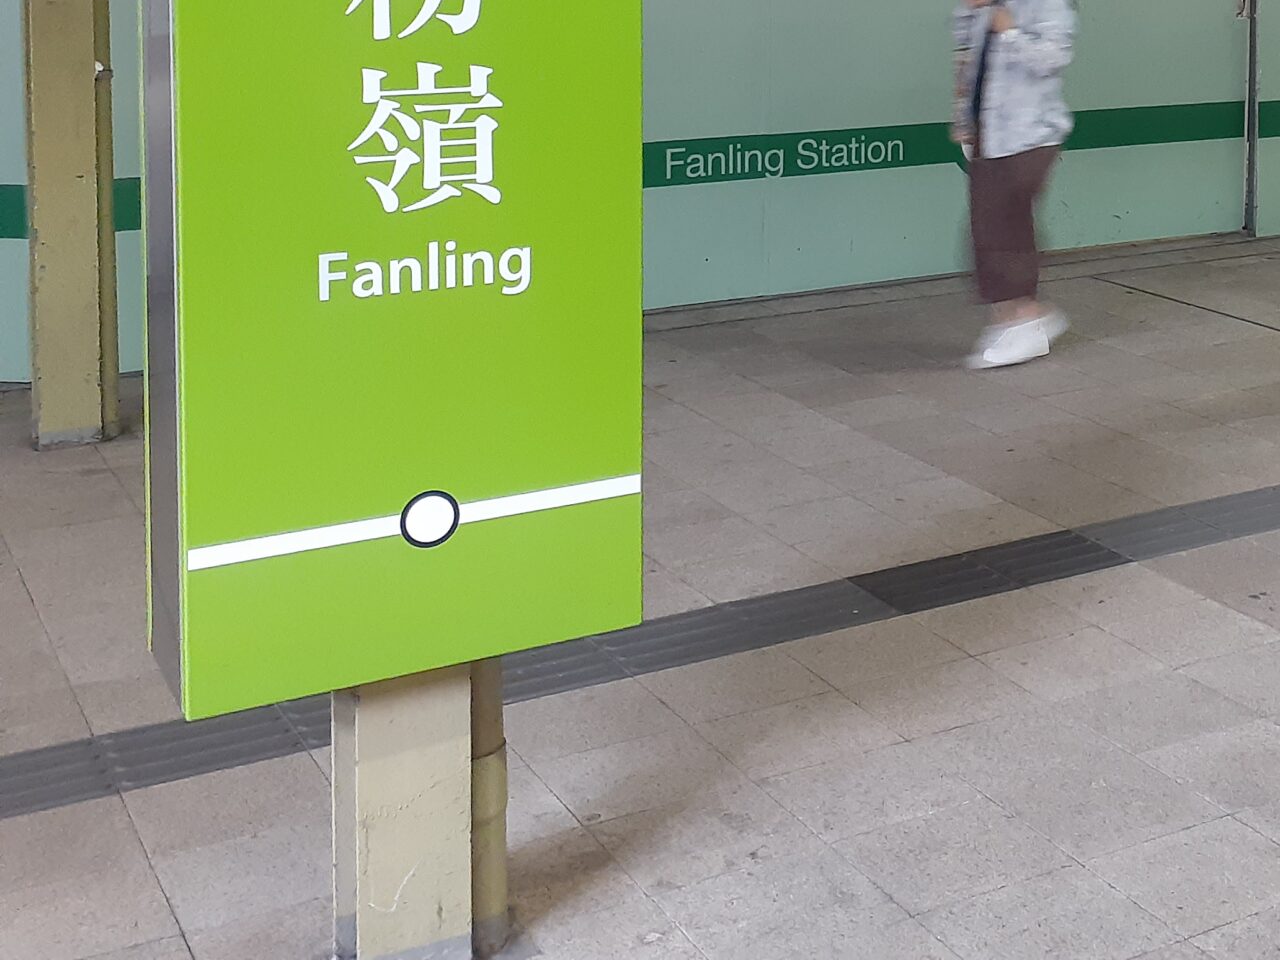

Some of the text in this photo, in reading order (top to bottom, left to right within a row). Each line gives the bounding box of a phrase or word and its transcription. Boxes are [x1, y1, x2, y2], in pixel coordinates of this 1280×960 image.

[665, 135, 904, 179] Fanling Station
[317, 240, 532, 302] Fanling
